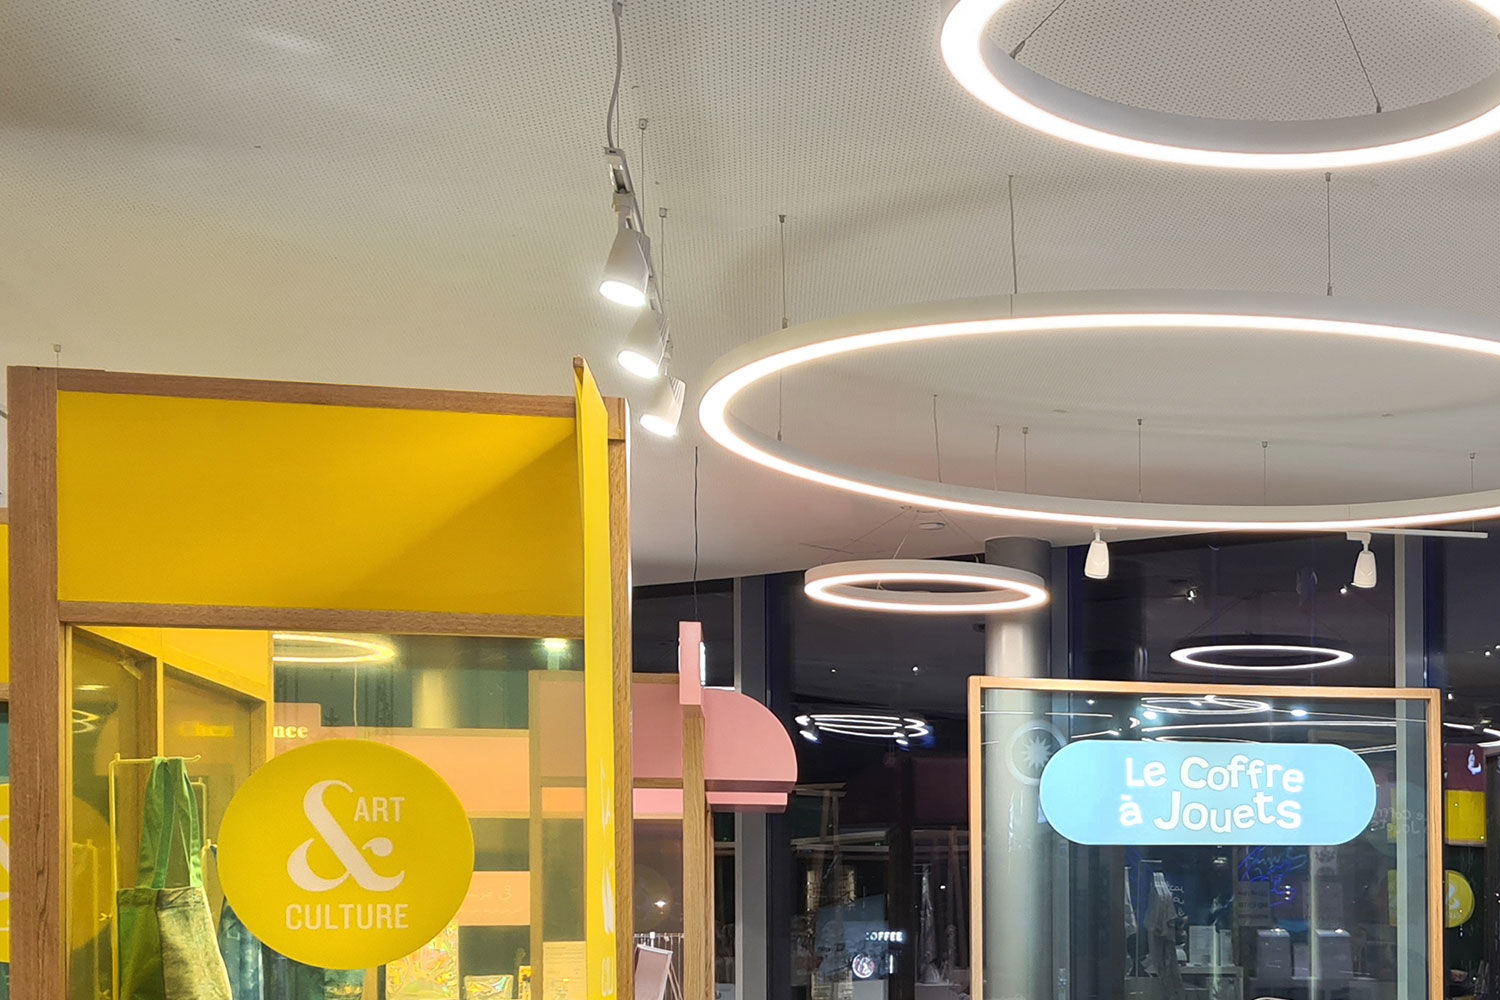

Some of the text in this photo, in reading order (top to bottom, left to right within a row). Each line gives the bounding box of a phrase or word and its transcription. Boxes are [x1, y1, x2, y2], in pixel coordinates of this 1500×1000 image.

[1124, 753, 1305, 794] Le Coffre
[353, 796, 405, 823] ART
[1118, 790, 1303, 834] à Jouets
[285, 903, 410, 931] CULTURE
[866, 931, 904, 942] OFFEE
